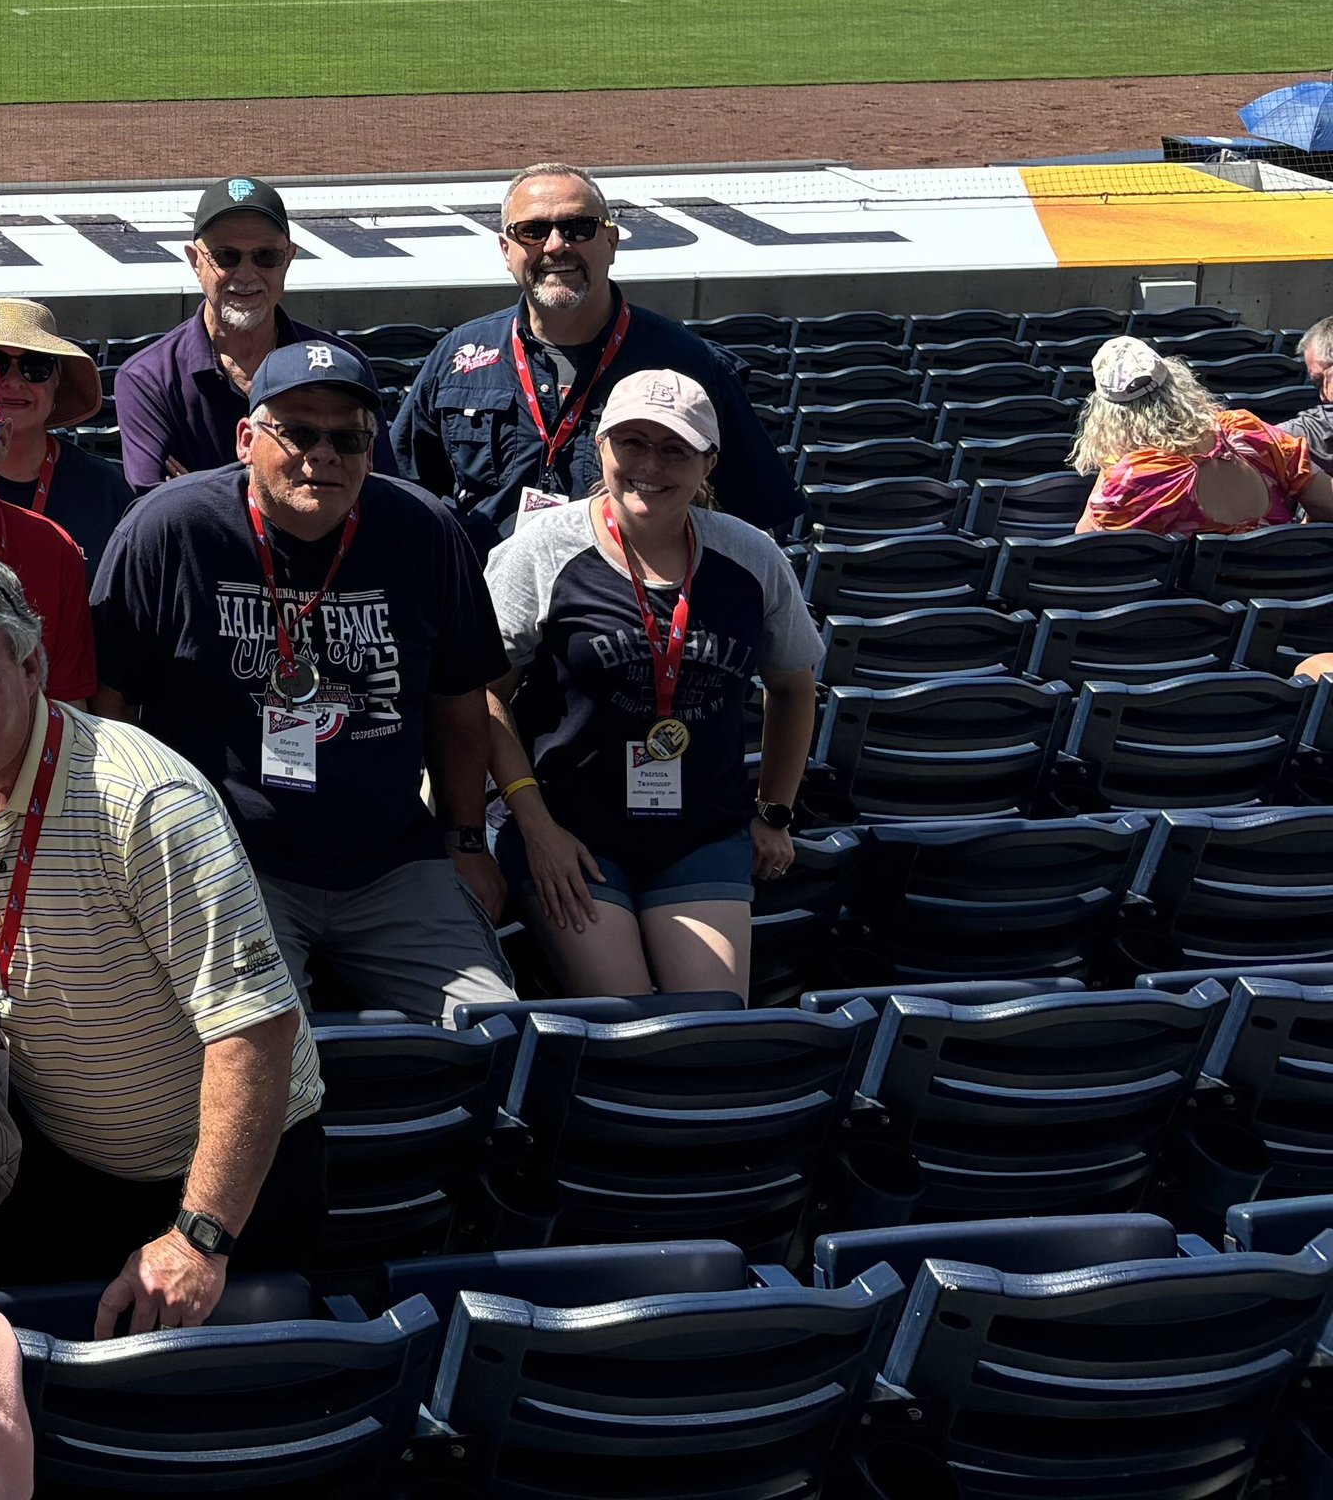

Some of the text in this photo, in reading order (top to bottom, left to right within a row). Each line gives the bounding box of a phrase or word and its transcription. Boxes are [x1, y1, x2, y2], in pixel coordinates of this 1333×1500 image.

[263, 586, 298, 600] NAIONAL
[216, 595, 277, 642] HALL
[321, 603, 395, 644] FAME
[587, 628, 753, 678] BASBALL
